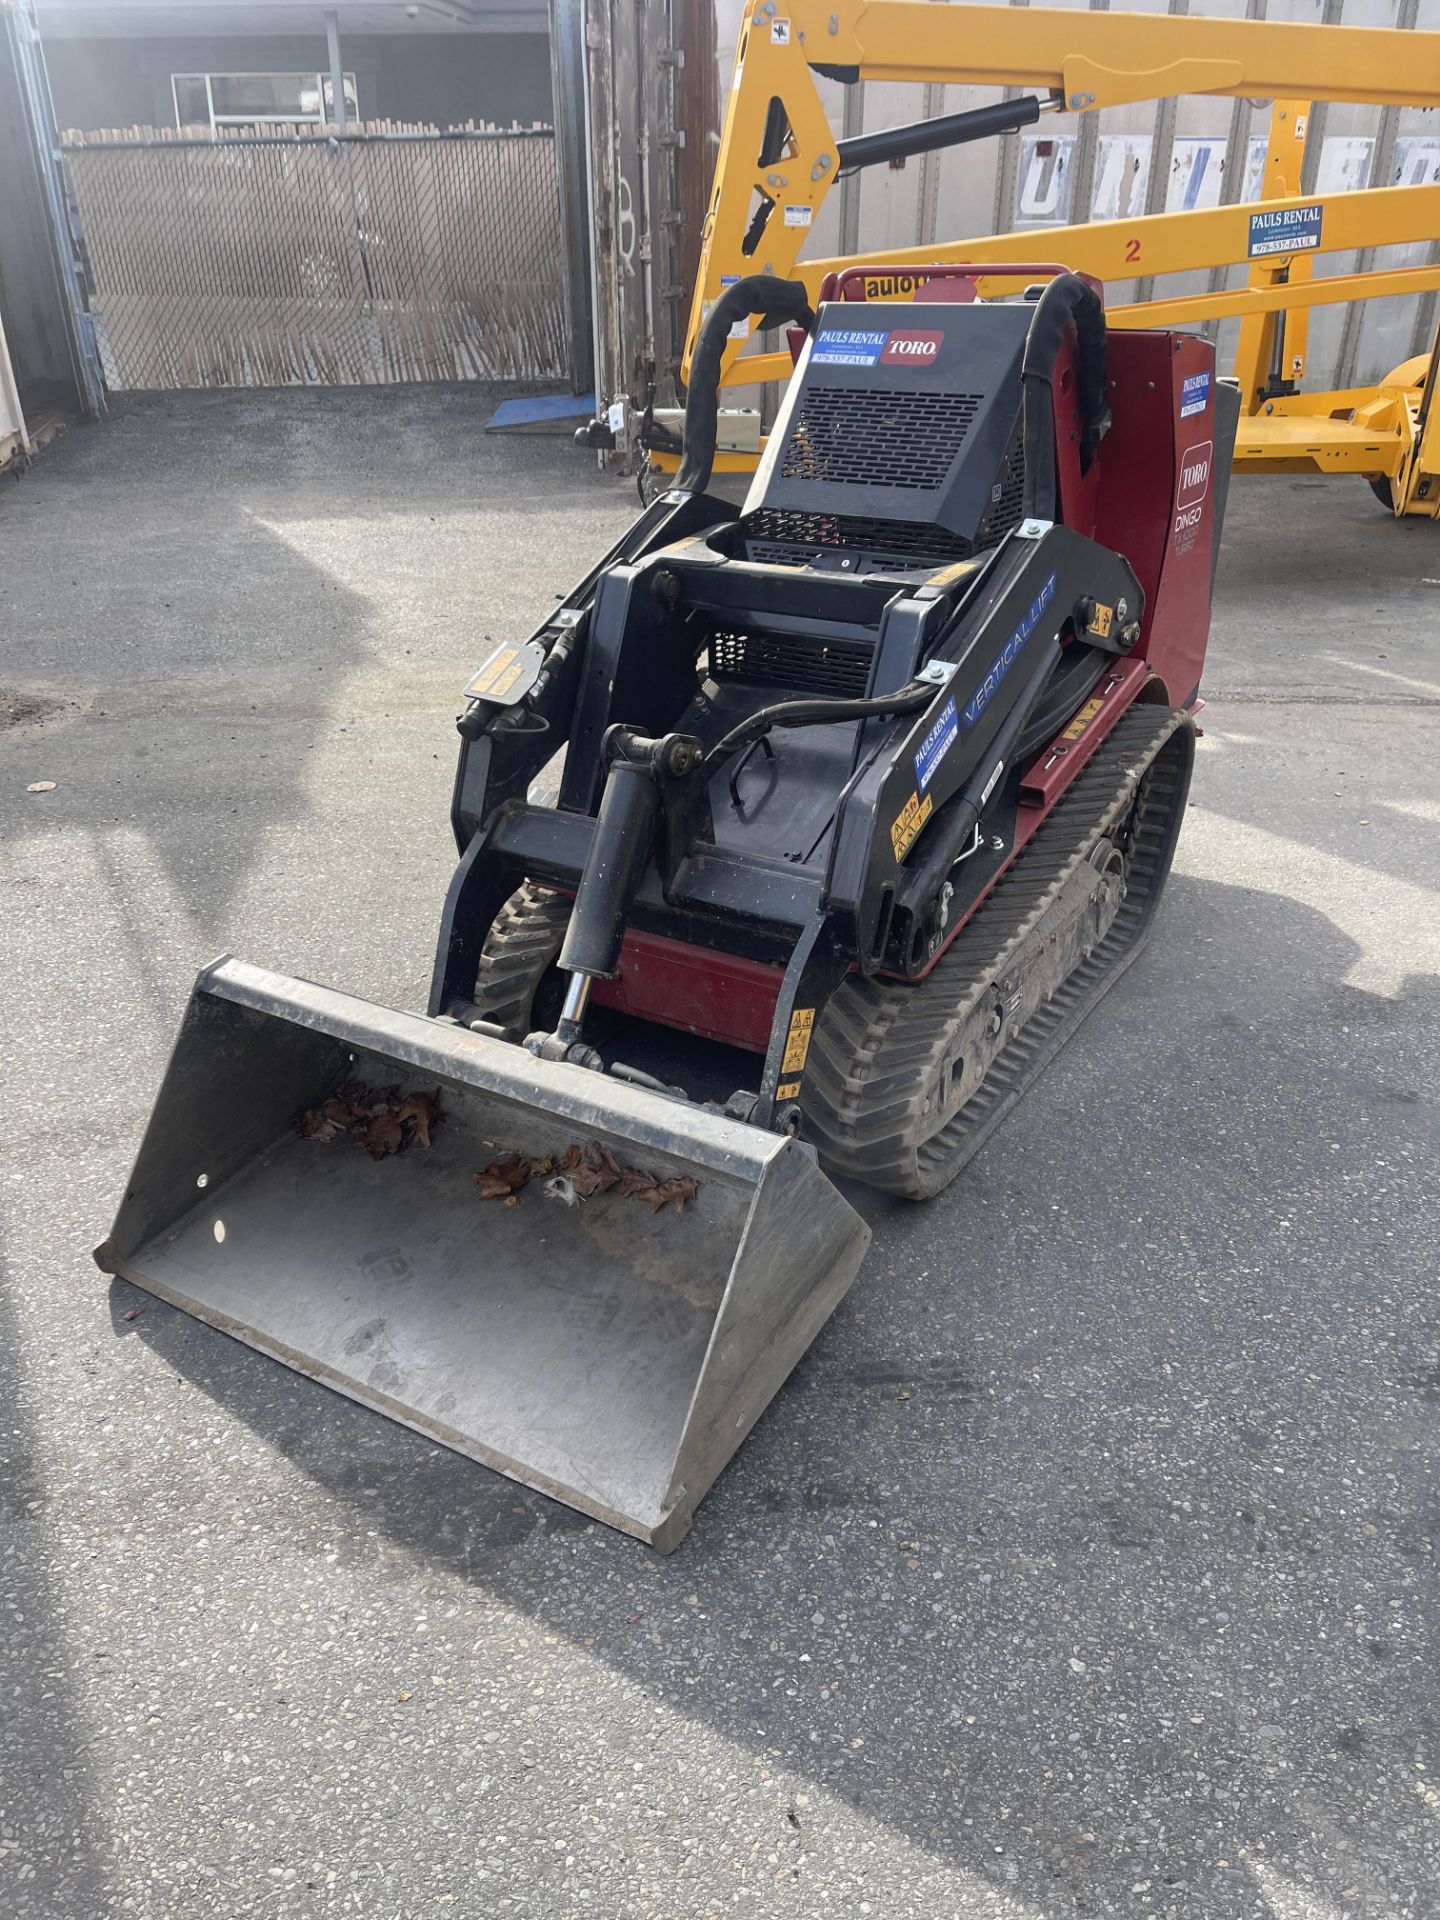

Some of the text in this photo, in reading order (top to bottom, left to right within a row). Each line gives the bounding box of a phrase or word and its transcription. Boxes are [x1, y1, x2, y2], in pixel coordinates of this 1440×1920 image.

[1252, 212, 1282, 230] PAULS
[1283, 207, 1320, 225] RENTAL
[1125, 239, 1141, 263] 2
[819, 331, 885, 345] PAULS RENTAL
[889, 340, 936, 355] TORO
[1182, 461, 1208, 490] TORO
[1175, 507, 1202, 533] DINGO
[965, 623, 1030, 721] VERTICAL
[1031, 575, 1055, 623] LIFT
[915, 732, 934, 769] PAULS
[933, 701, 955, 740] RENTAL
